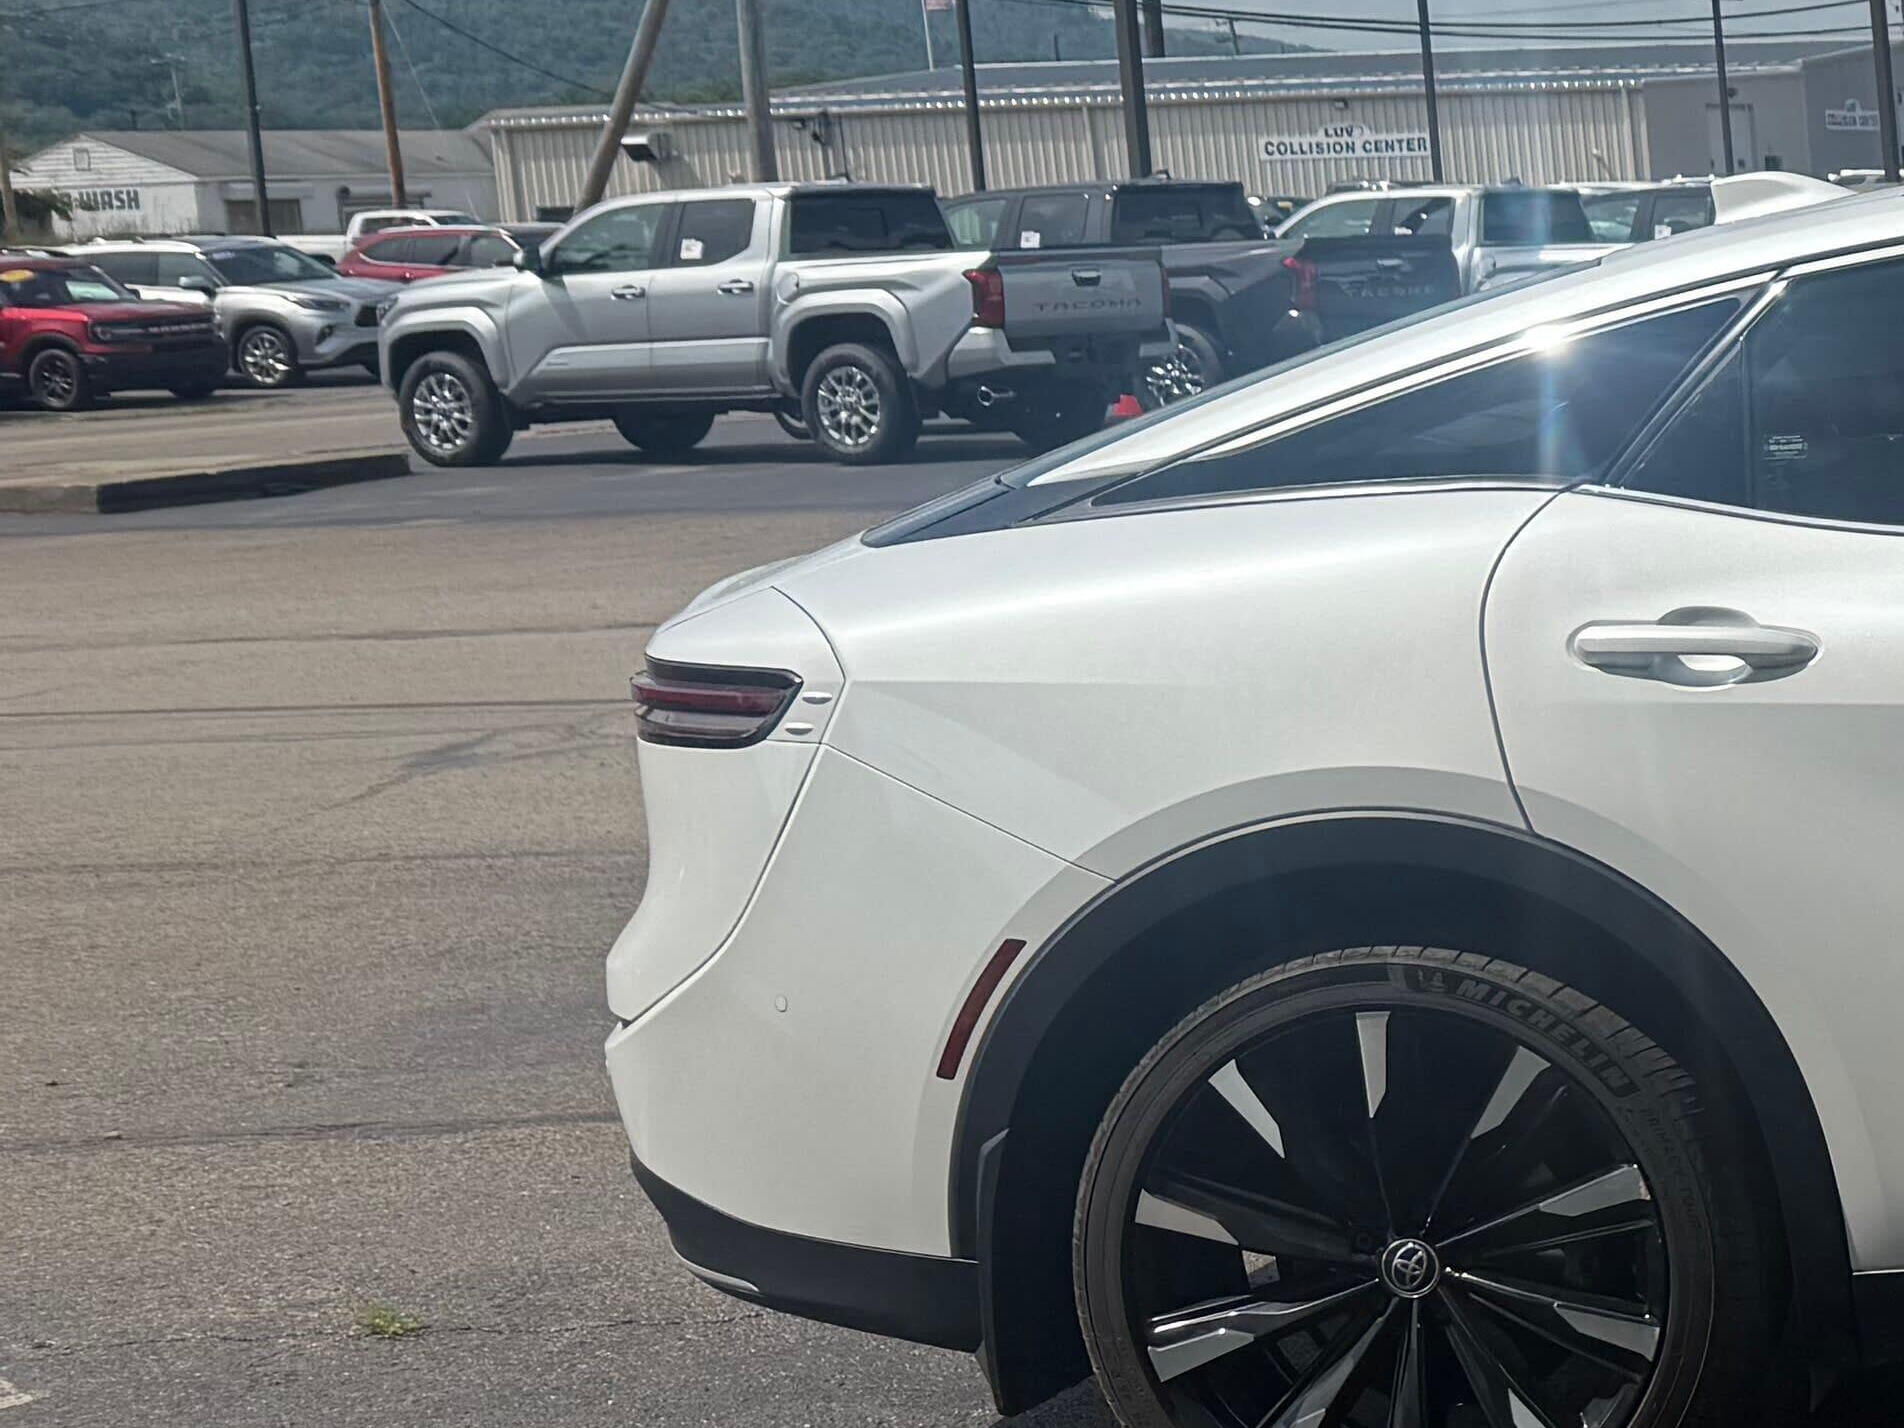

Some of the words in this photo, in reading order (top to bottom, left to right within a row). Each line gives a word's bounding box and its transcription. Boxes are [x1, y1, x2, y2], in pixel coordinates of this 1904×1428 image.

[1264, 140, 1356, 156] COLLISION
[1361, 136, 1428, 154] CENTER
[1455, 978, 1631, 1090] MICHELIN
